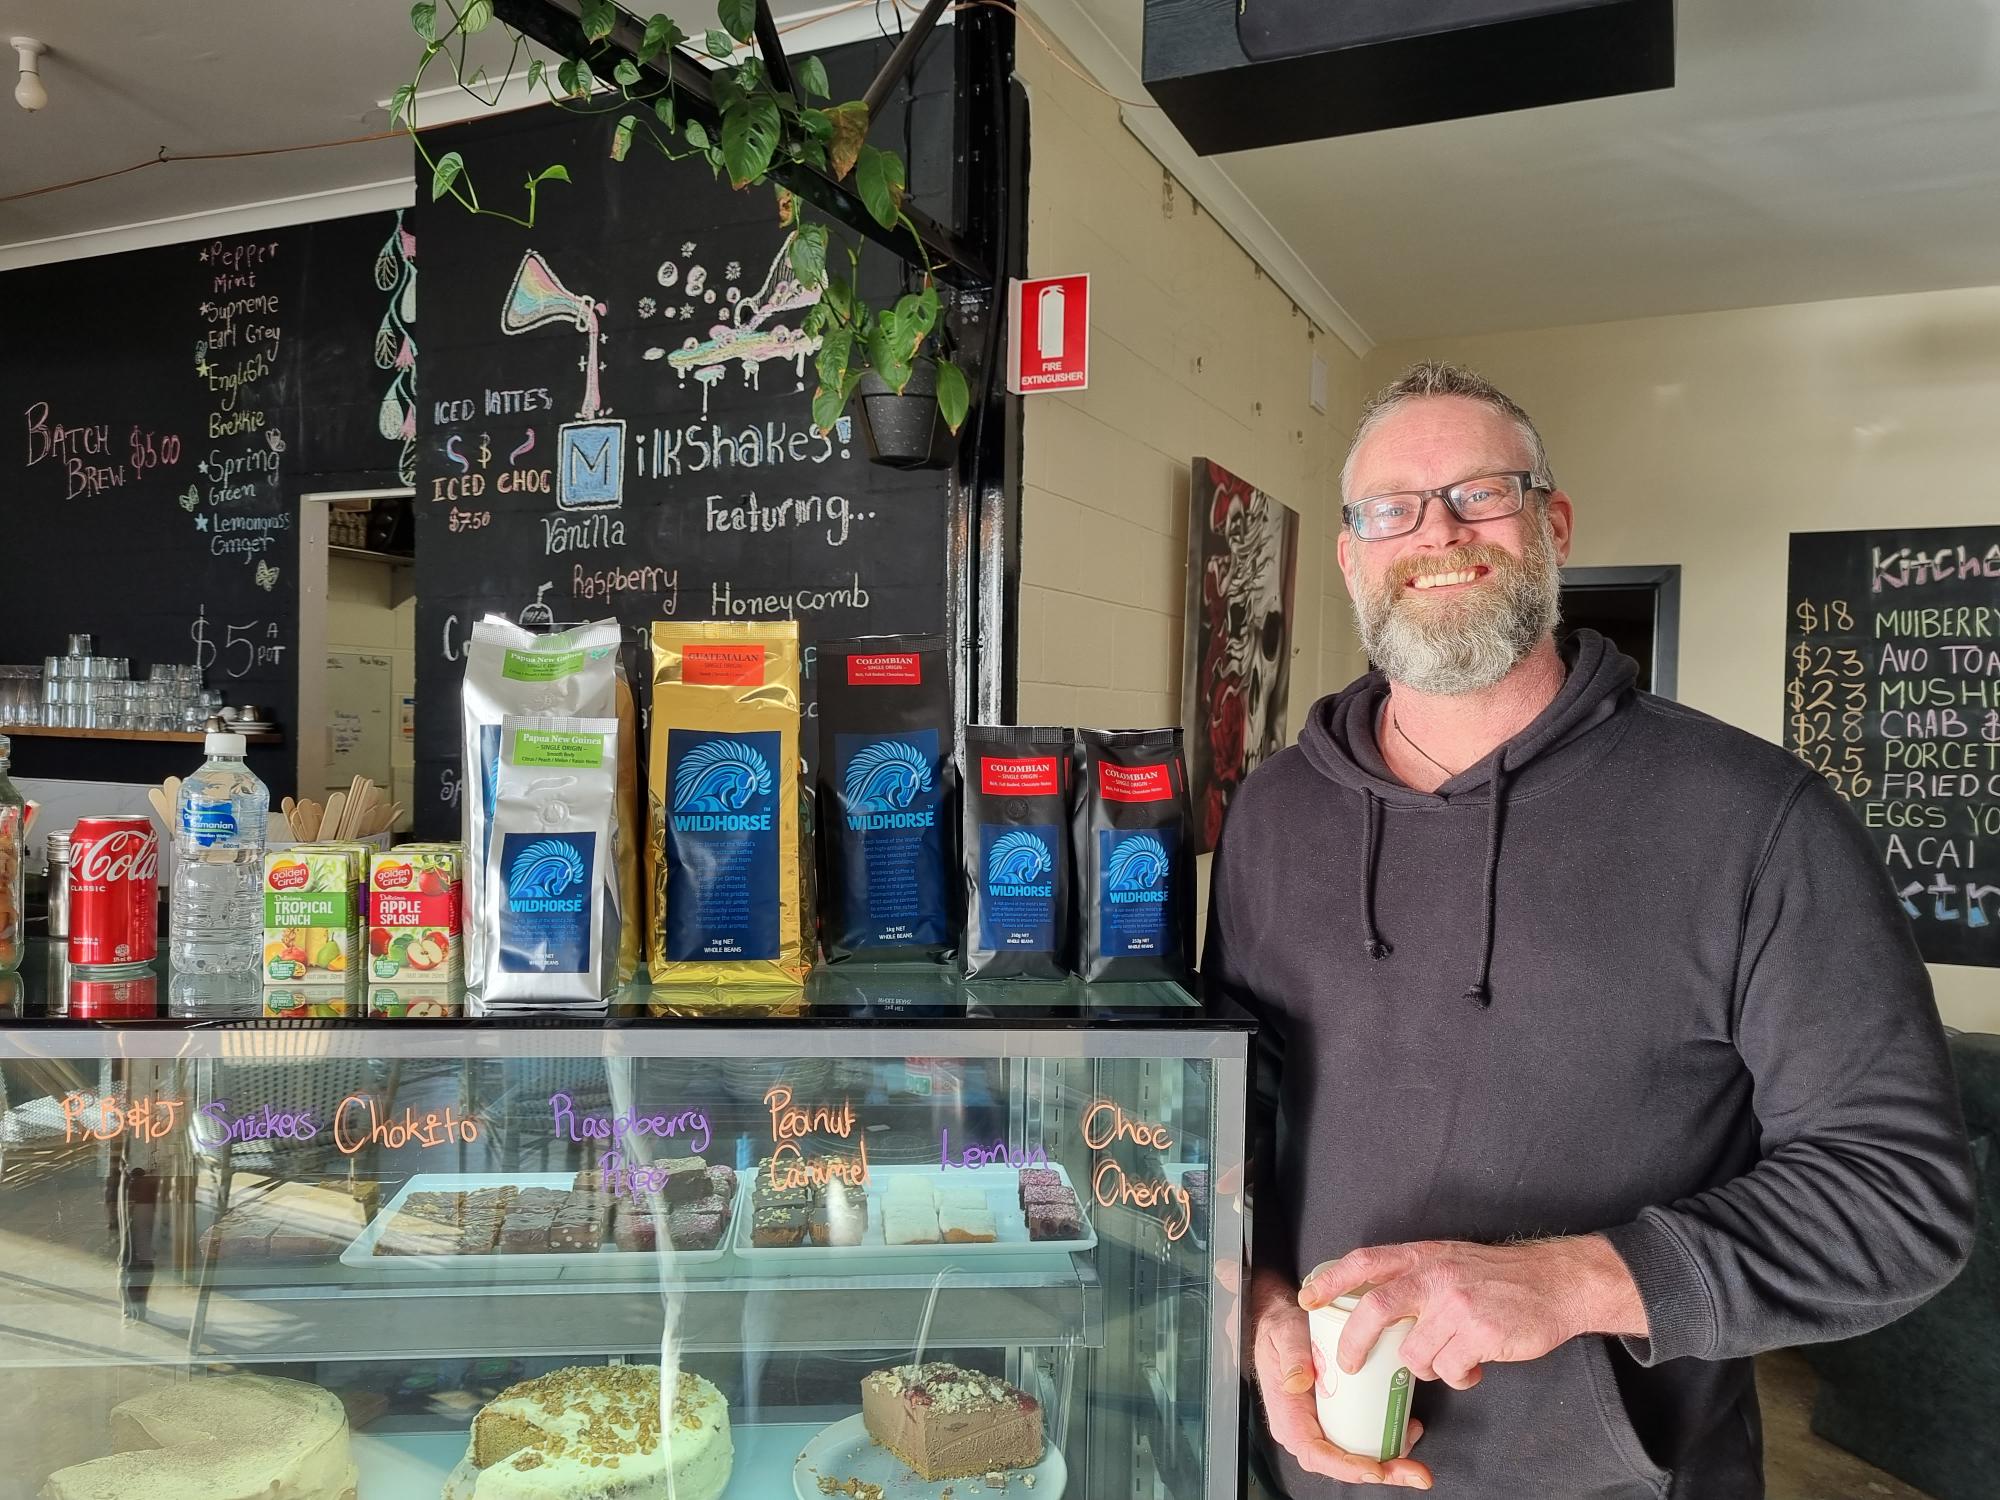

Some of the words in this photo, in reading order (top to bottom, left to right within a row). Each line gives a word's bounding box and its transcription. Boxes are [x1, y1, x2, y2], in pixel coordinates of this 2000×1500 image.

[210, 241, 279, 271] Pepper
[214, 272, 256, 293] Mint
[208, 295, 279, 332] Supreme
[208, 324, 236, 349] Earl
[246, 324, 280, 362] Grey
[1022, 371, 1084, 386] EXTINGUISHER
[1042, 361, 1062, 372] FIRE
[434, 399, 475, 425] ICED
[25, 401, 111, 466] BATCH
[209, 448, 280, 489] Spring
[208, 483, 257, 506] Green
[432, 474, 486, 502] ICED
[497, 469, 552, 494] CHOC
[540, 514, 627, 555] Vanilla
[573, 563, 678, 615] Raspberry
[711, 572, 870, 622] Honeycomb
[1796, 598, 1854, 634] $18
[191, 603, 259, 678] $5
[267, 622, 279, 638] A
[258, 645, 286, 666] POT
[688, 652, 759, 662] GUATEMALAN
[856, 657, 913, 665] COLOMBIAN
[1793, 641, 1864, 677] $23
[1879, 643, 1928, 675] AVO
[1787, 676, 1867, 712] $23
[523, 733, 550, 743] Papua
[551, 735, 570, 743] New
[571, 736, 602, 745] Guinea
[1791, 711, 1864, 747] $28
[1880, 709, 1968, 739] CRAB
[990, 764, 1050, 773] COLOMBIAN
[1105, 768, 1158, 781] COLOMBIAN
[1882, 771, 1980, 800] FRIED
[192, 820, 234, 830] asmanian
[674, 815, 771, 832] WILDHORSE
[847, 811, 935, 831] WILDHORSE
[1865, 800, 1946, 829] EGGS
[1885, 833, 1980, 870] ACAI
[272, 868, 306, 881] golden
[277, 876, 304, 887] circle
[377, 867, 411, 882] golden
[382, 877, 408, 887] circle
[988, 885, 1052, 897] WILDHORSE
[1109, 890, 1169, 904] WILDHORSE
[274, 901, 334, 914] TROPICAL
[380, 900, 422, 913] APPLE
[509, 899, 583, 912] WILDHORSE
[275, 914, 311, 926] PUNCH
[380, 914, 419, 925] SPLASH
[200, 1102, 318, 1148] Snickers
[334, 1096, 478, 1154] Chokito
[548, 1092, 712, 1153] Raspberry
[763, 1087, 856, 1142] Peanut
[1084, 1104, 1174, 1150] Choc
[940, 1128, 1052, 1172] Lemon
[1095, 1163, 1190, 1241] Cherry
